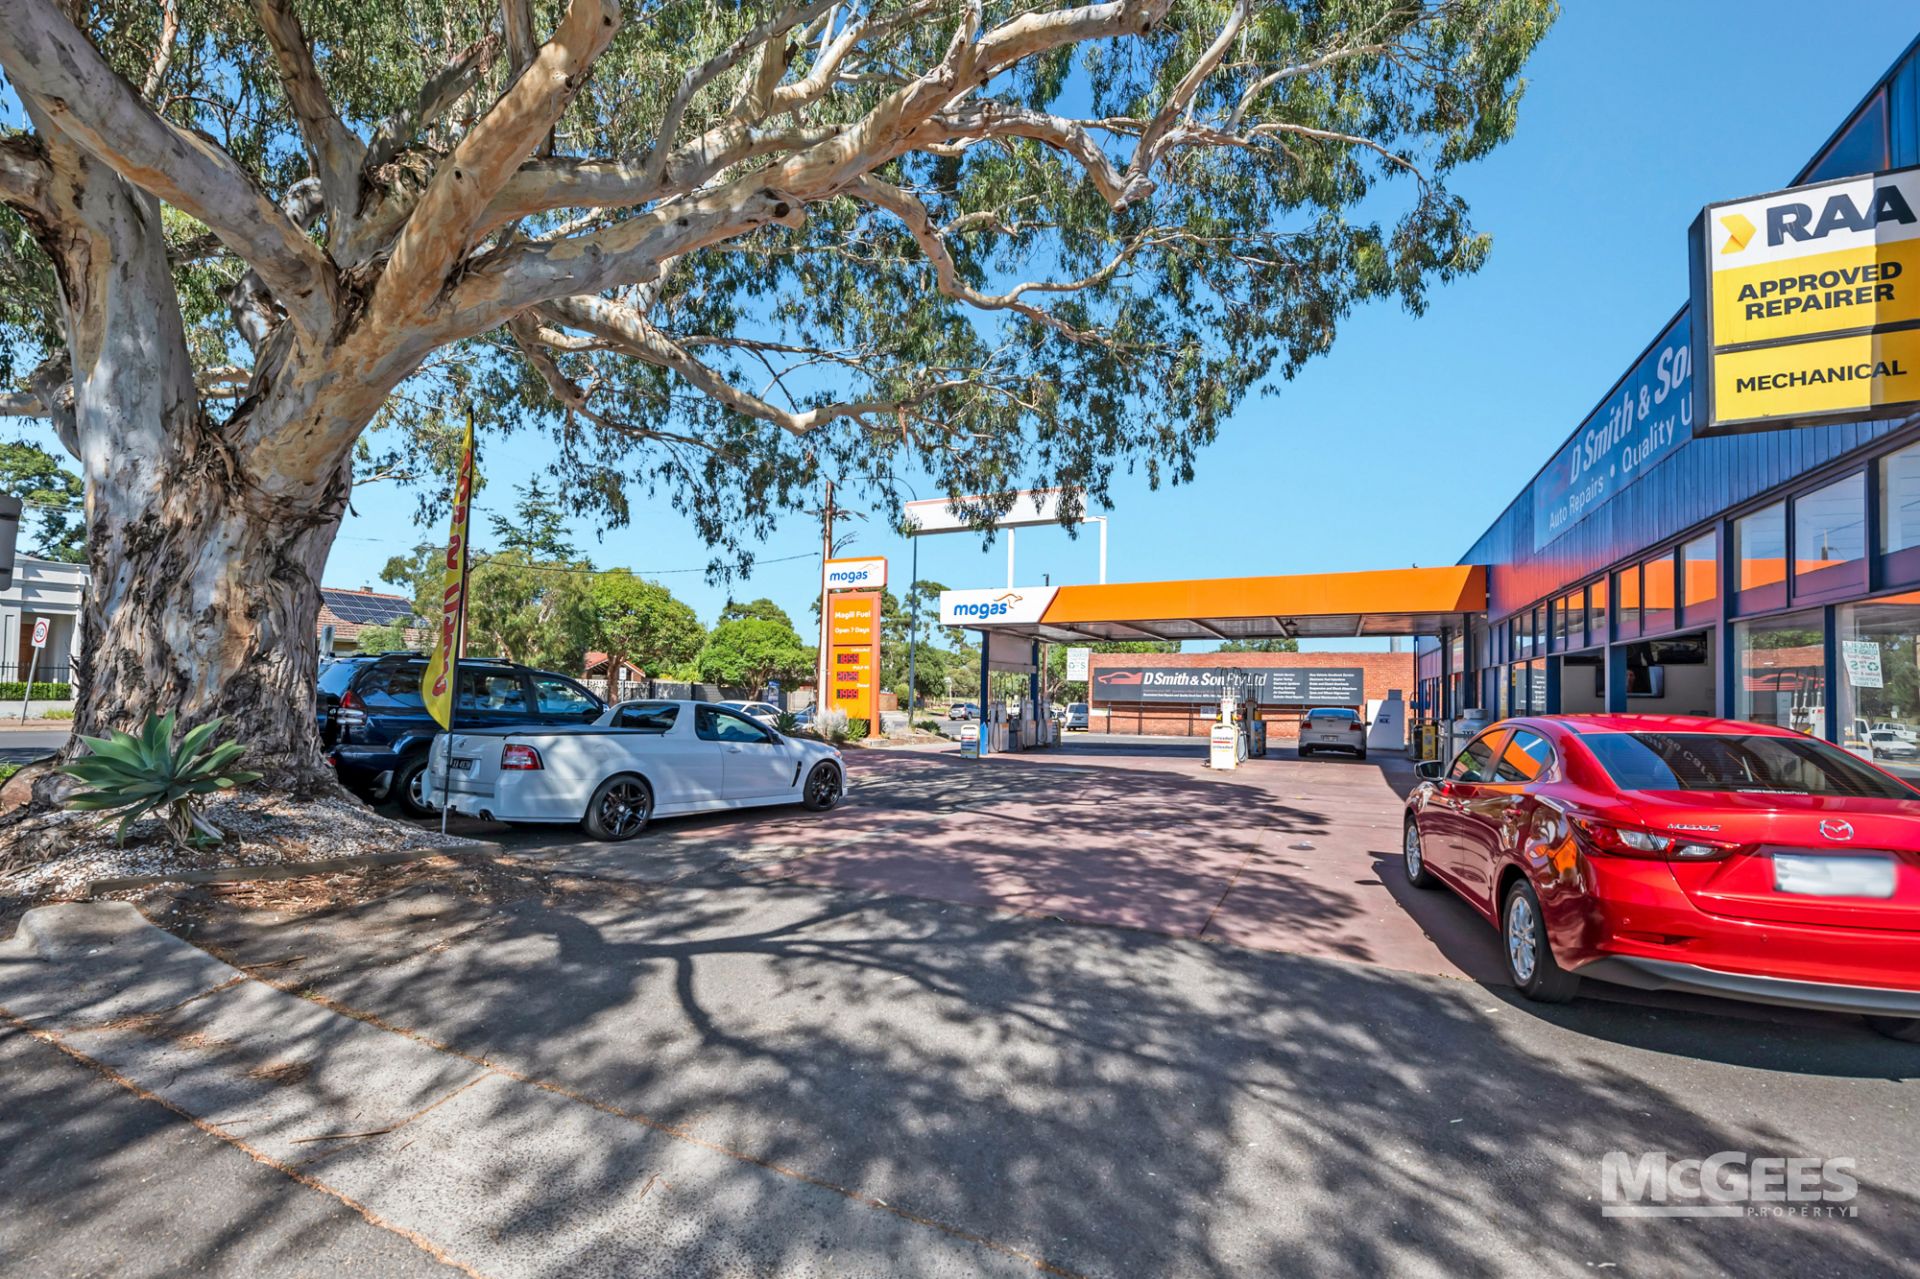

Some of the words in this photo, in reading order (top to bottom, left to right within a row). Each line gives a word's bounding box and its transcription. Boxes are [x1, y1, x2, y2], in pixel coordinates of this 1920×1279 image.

[1766, 185, 1917, 247] RAA
[1737, 261, 1903, 302] APPROVED
[1745, 283, 1895, 321] REPAIRER
[1736, 360, 1907, 393] MECHANICAL
[1569, 444, 1582, 486] D
[1583, 391, 1635, 472] Smith
[1638, 384, 1650, 421] &
[1549, 506, 1568, 530] Auto
[1569, 475, 1605, 513] Repairs
[1622, 415, 1676, 474] Quality
[829, 569, 868, 584] mogas
[856, 609, 871, 618] Fuel
[953, 602, 1008, 620] mogas
[1143, 672, 1154, 685] D
[1153, 671, 1190, 686] Smith
[1190, 675, 1200, 686] &
[1200, 671, 1225, 686] Son
